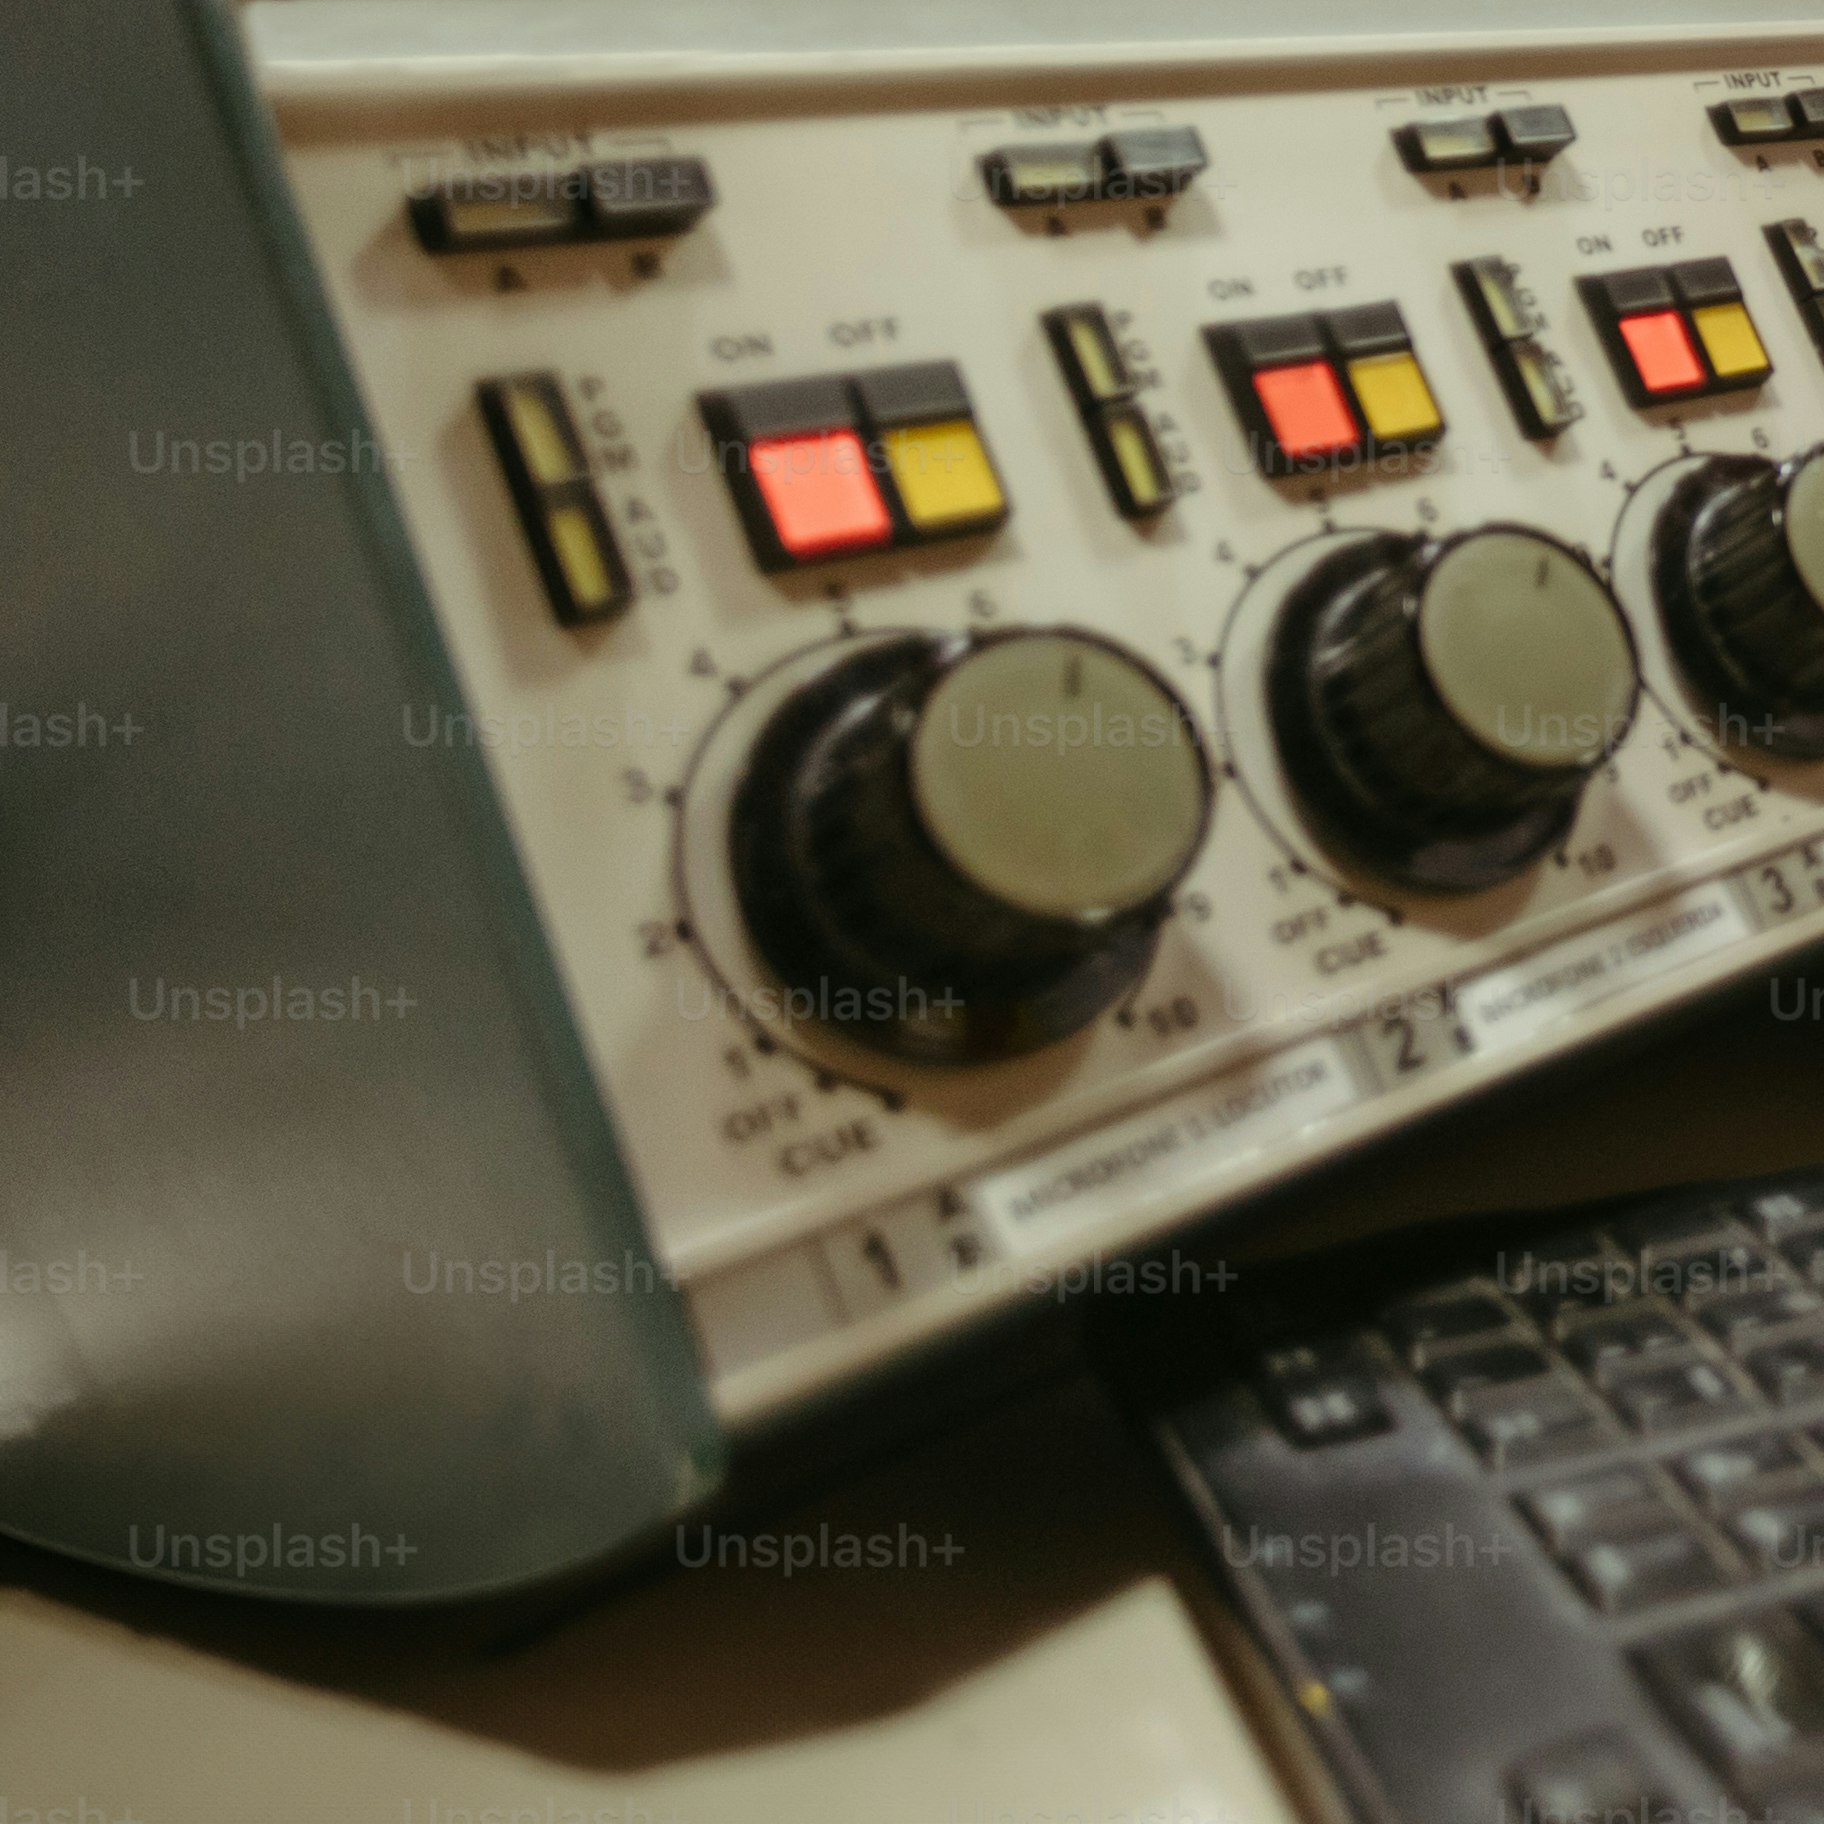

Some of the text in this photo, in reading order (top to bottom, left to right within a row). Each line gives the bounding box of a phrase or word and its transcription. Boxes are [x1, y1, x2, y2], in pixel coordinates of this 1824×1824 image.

[1414, 85, 1489, 106] INPUT
[1723, 70, 1782, 90] INPUT
[1754, 154, 1773, 173] A
[1576, 224, 1686, 256] ON OFF
[1207, 265, 1348, 301] ON OFF
[708, 317, 899, 361] ON OFF
[1751, 426, 1770, 451] 6
[1666, 772, 1711, 806] OFF
[1702, 797, 1760, 833] CUE
[1760, 865, 1796, 914] 3
[1269, 907, 1328, 945] OFF
[1313, 930, 1387, 977] CUE
[1383, 1018, 1425, 1073] 2
[721, 1095, 800, 1145] OFF
[778, 1119, 877, 1176] CUE
